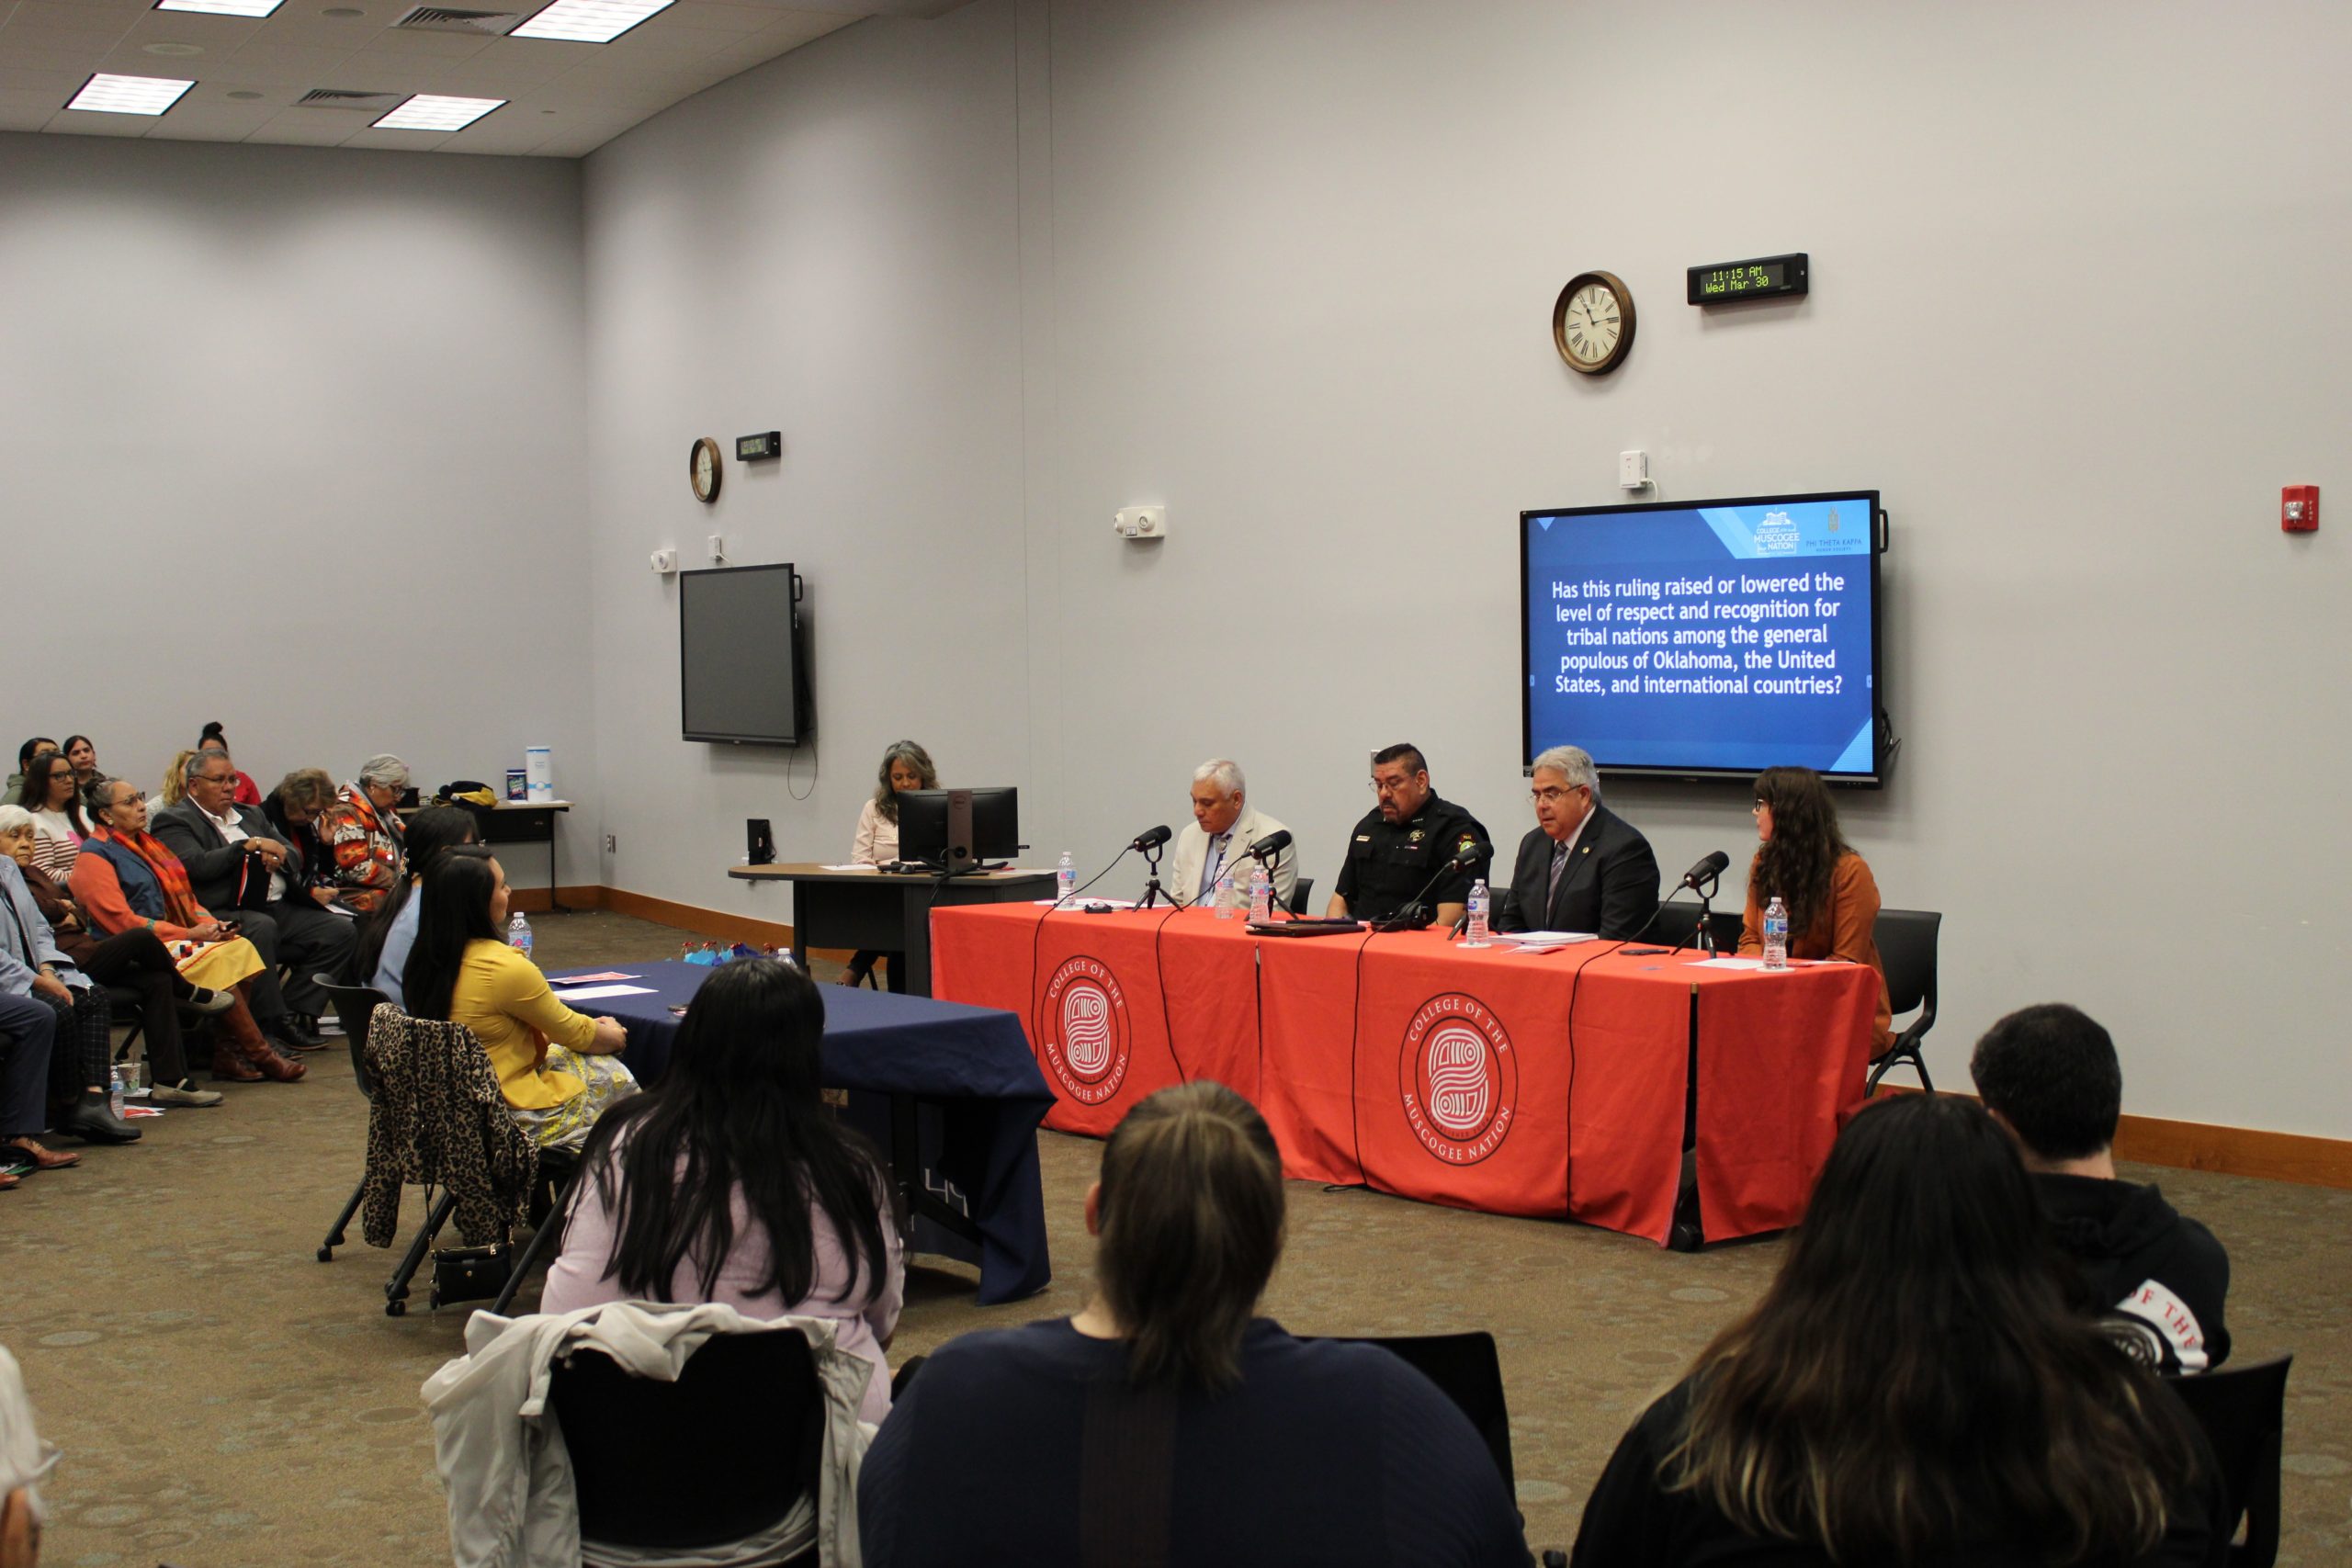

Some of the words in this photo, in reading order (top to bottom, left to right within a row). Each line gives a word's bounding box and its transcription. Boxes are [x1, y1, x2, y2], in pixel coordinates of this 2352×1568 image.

[1705, 281, 1724, 293] Wed
[1730, 279, 1749, 291] Mar
[1756, 276, 1769, 288] 30
[1713, 267, 1744, 282] 11:15
[1748, 265, 1762, 277] AM
[1753, 533, 1801, 544] MUSCOGEE
[1768, 541, 1794, 550] NATION
[1552, 581, 1578, 599] Has
[1582, 580, 1611, 598] this
[1615, 578, 1660, 601] ruling
[1665, 575, 1713, 595] raised
[1717, 579, 1736, 594] or
[1741, 572, 1809, 593] lowered
[1815, 571, 1845, 592] the
[1556, 603, 1592, 622] level
[1596, 603, 1612, 621] of
[1616, 603, 1675, 625] respect
[1679, 600, 1709, 620] and
[1713, 599, 1809, 623] recognition
[1815, 597, 1841, 617] for
[1566, 626, 1608, 646] tribal
[1612, 626, 1668, 645] nations
[1673, 629, 1726, 649] among
[1730, 625, 1759, 644] the
[1764, 623, 1828, 649] general
[1561, 651, 1629, 673] populous
[1633, 650, 1650, 670] of
[1653, 650, 1738, 673] Oklahoma,
[1744, 649, 1773, 669] the
[1778, 649, 1836, 669] United
[1555, 675, 1606, 696] States,
[1611, 674, 1639, 694] and
[1644, 674, 1748, 694] international
[1753, 675, 1843, 694] countries?
[1049, 961, 1086, 998] COLLEGE
[1090, 964, 1105, 979] OF
[1107, 977, 1124, 1009] THE
[1409, 998, 1460, 1042] COLLEGE
[1465, 1002, 1482, 1020] OF
[1486, 1019, 1508, 1054] THE
[1046, 1043, 1092, 1100] MUSCOGEE
[1096, 1054, 1126, 1100] NATION
[1404, 1094, 1463, 1160] MUSCOGEE
[1469, 1107, 1510, 1159] NATION
[2163, 1301, 2197, 1349] THE
